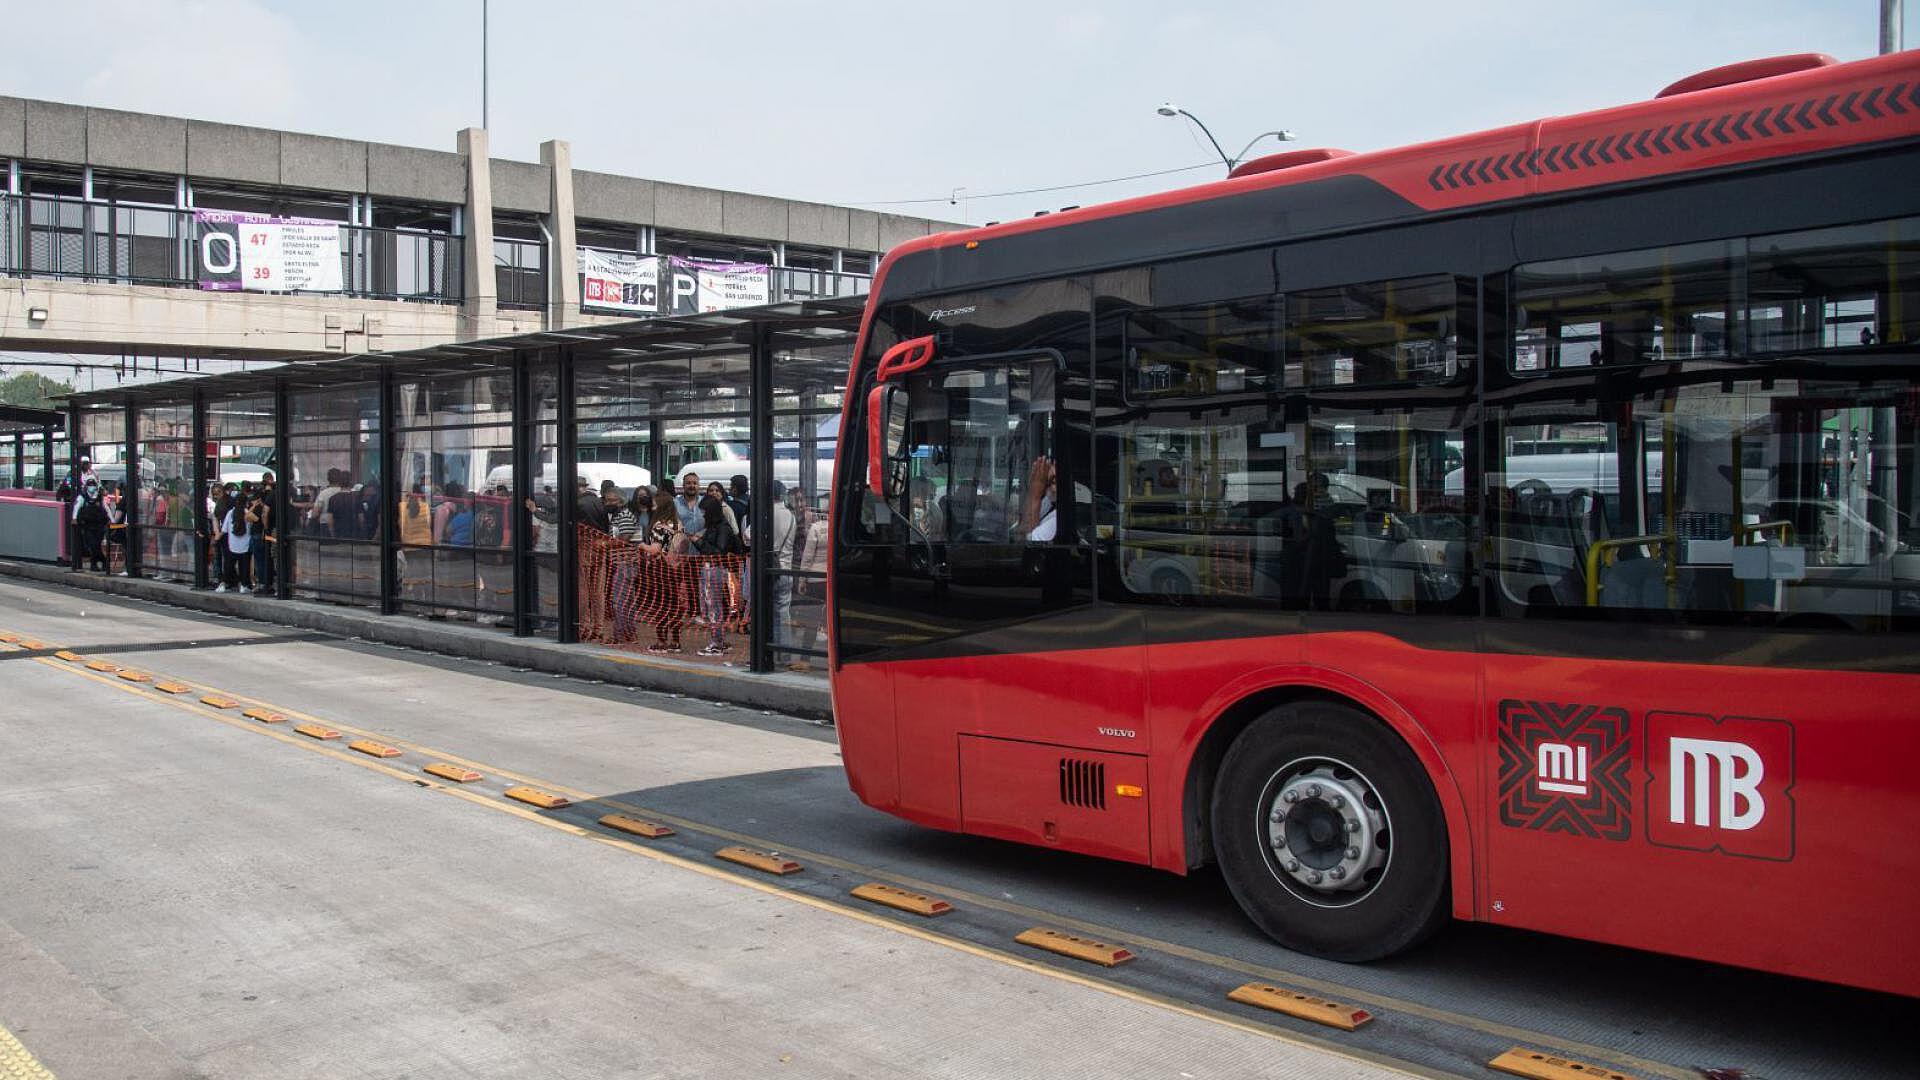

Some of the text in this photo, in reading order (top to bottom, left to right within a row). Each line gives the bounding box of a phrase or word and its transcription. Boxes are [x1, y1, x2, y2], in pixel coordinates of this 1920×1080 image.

[250, 233, 268, 245] 47
[253, 267, 270, 279] 39
[673, 273, 696, 309] P
[1097, 726, 1136, 738] VOLVO
[1670, 737, 1766, 830] MB
